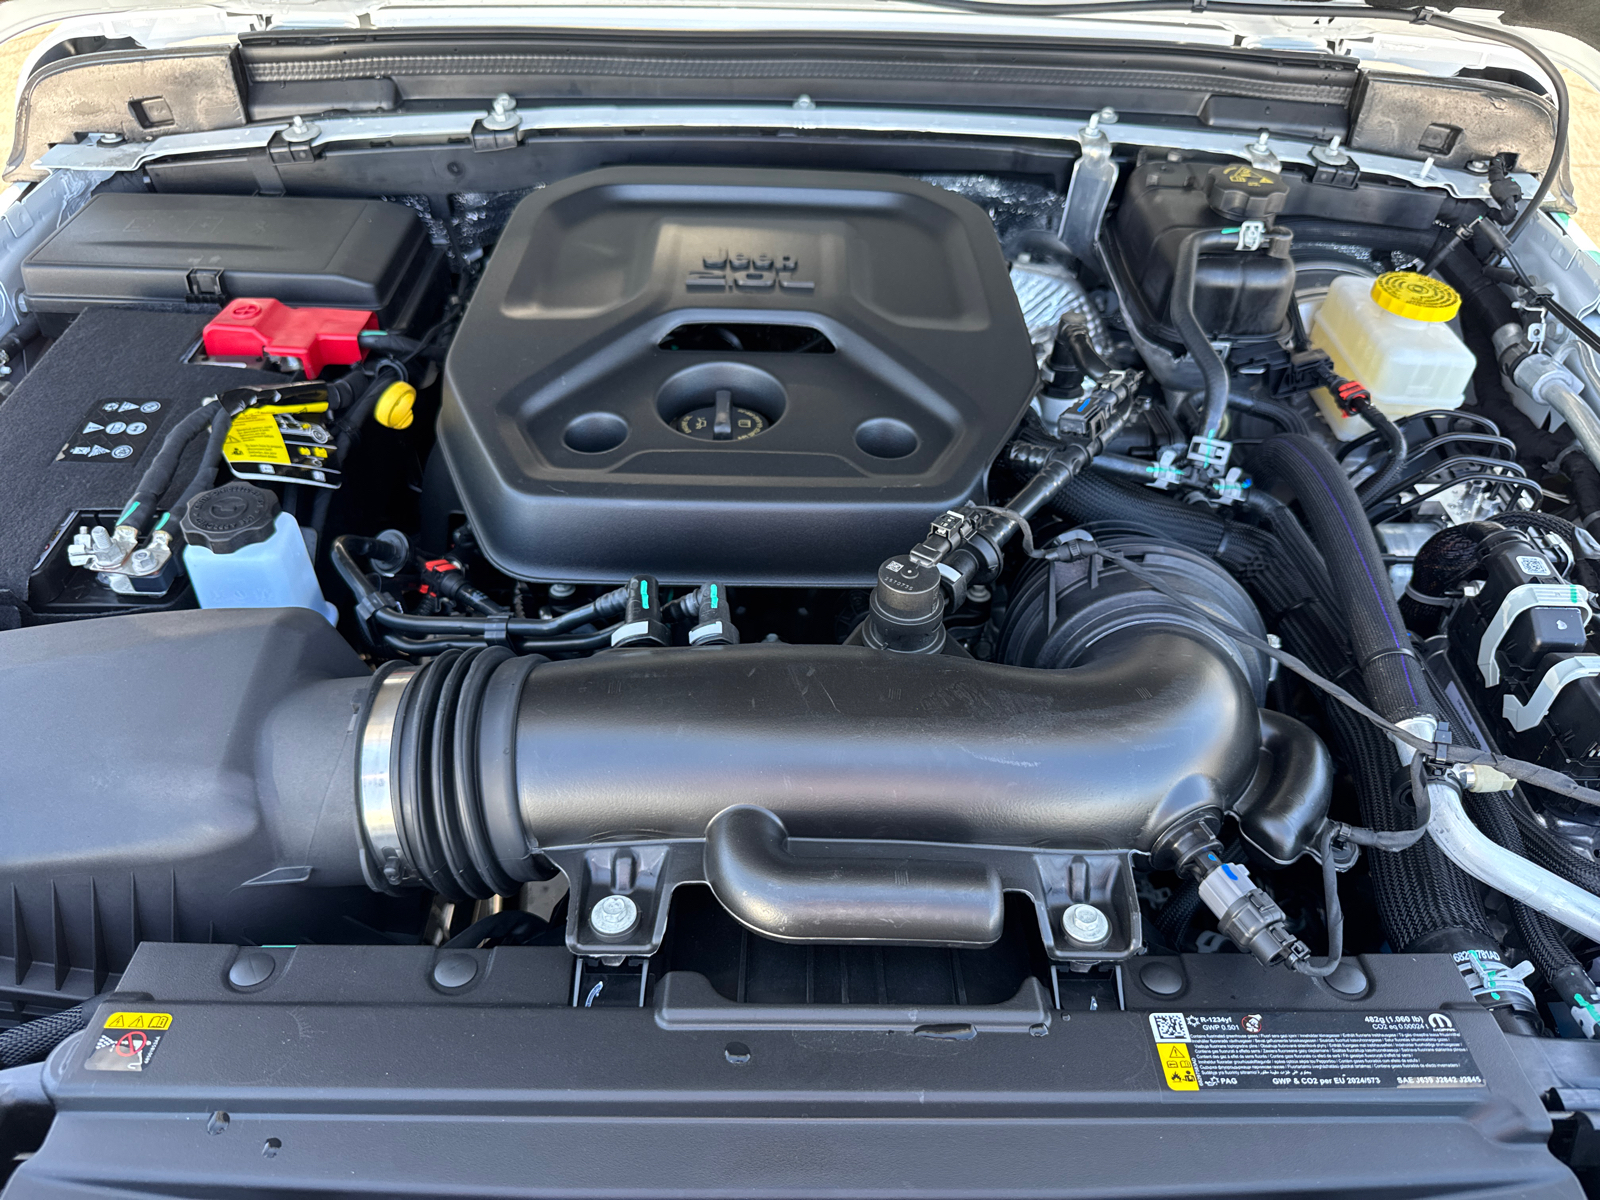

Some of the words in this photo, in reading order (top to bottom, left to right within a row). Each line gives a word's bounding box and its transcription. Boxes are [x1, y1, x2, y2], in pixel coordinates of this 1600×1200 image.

[702, 249, 799, 272] Jeep
[1453, 949, 1501, 963] 682781AD
[1220, 1077, 1238, 1085] PAG
[1272, 1077, 1291, 1085] GWP
[1293, 1077, 1300, 1085] &
[1301, 1077, 1318, 1085] CO2
[1320, 1078, 1332, 1086] per
[1396, 1076, 1414, 1084] SAE
